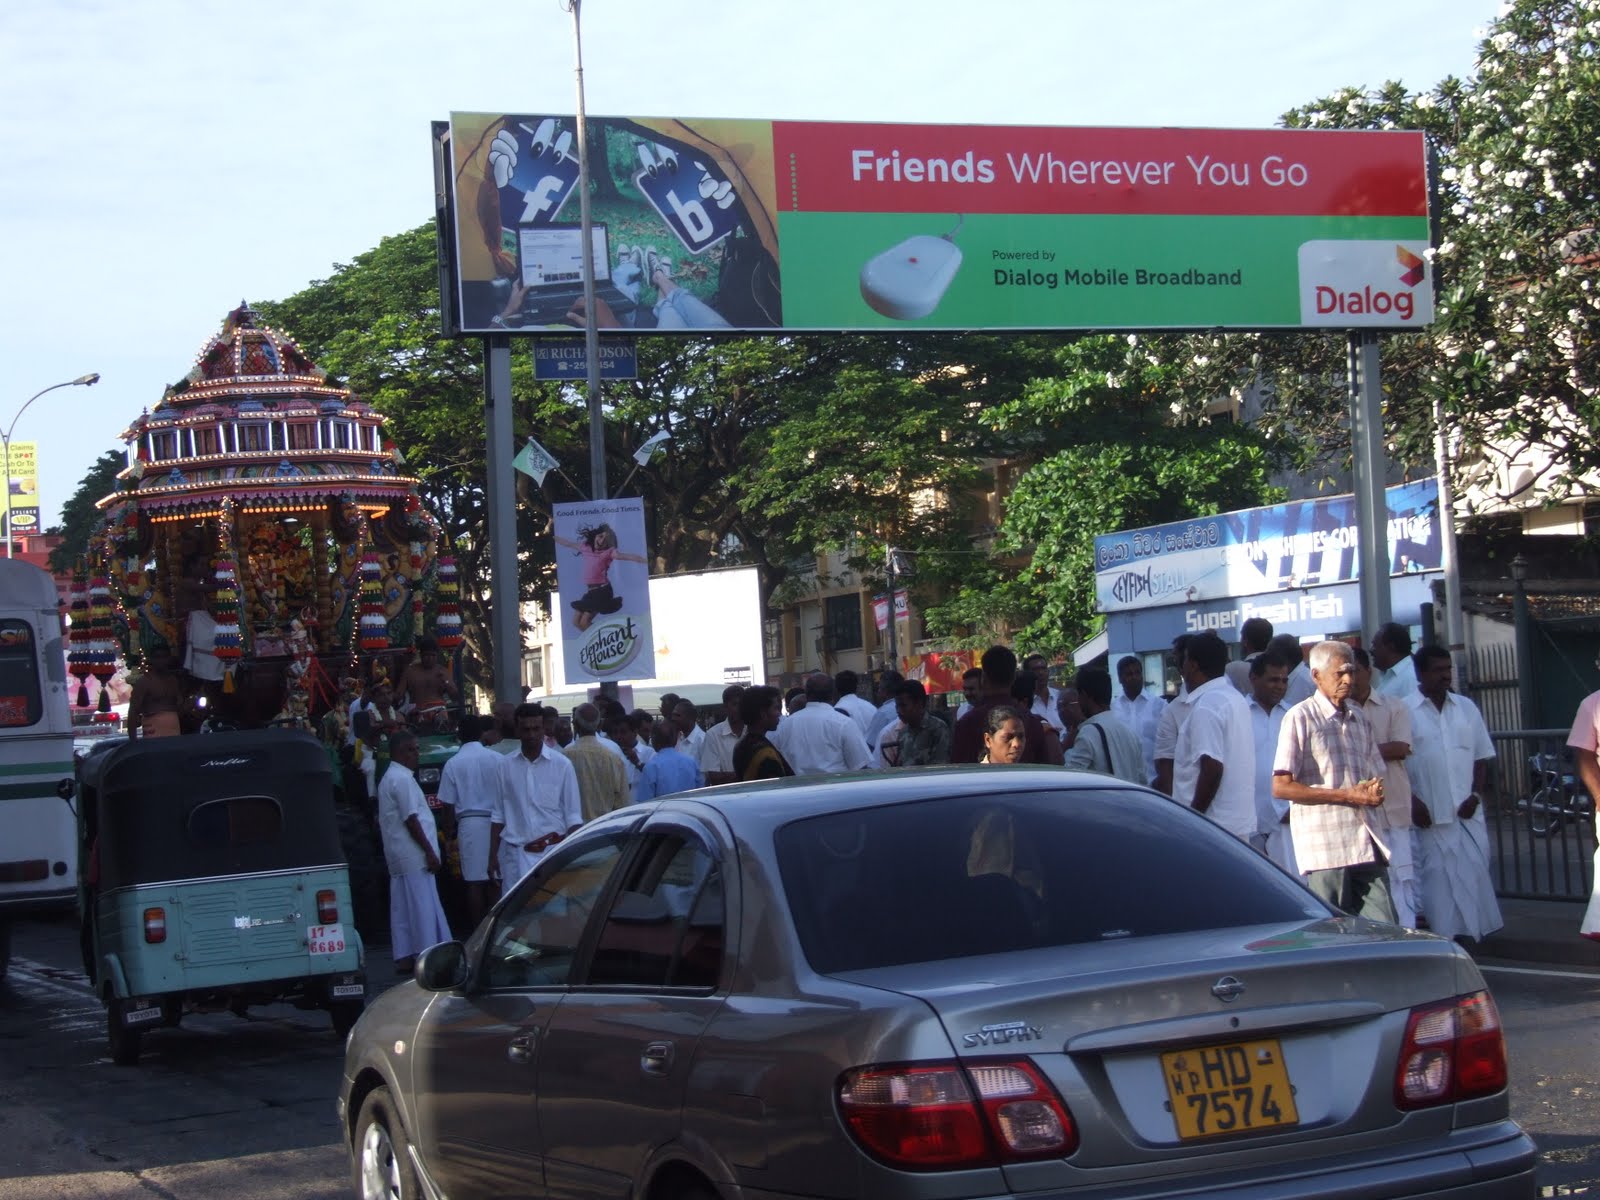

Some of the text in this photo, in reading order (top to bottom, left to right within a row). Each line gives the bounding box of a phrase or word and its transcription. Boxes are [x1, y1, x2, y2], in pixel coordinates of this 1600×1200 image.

[851, 150, 1308, 186] Friends Wherever You Go
[992, 250, 1056, 262] Powered by
[994, 268, 1242, 289] Dialog Mobile Broadband
[1315, 285, 1414, 321] Dialog
[551, 346, 633, 359] RICHDSON
[1112, 565, 1189, 603] CEYFISH STALL
[1299, 593, 1343, 621] Fish
[580, 617, 638, 666] Elephant
[589, 641, 626, 671] House
[309, 940, 345, 954] 6689
[963, 1026, 1044, 1048] SYLPHY
[1200, 1046, 1252, 1089] HD
[1186, 1084, 1282, 1133] 7574
